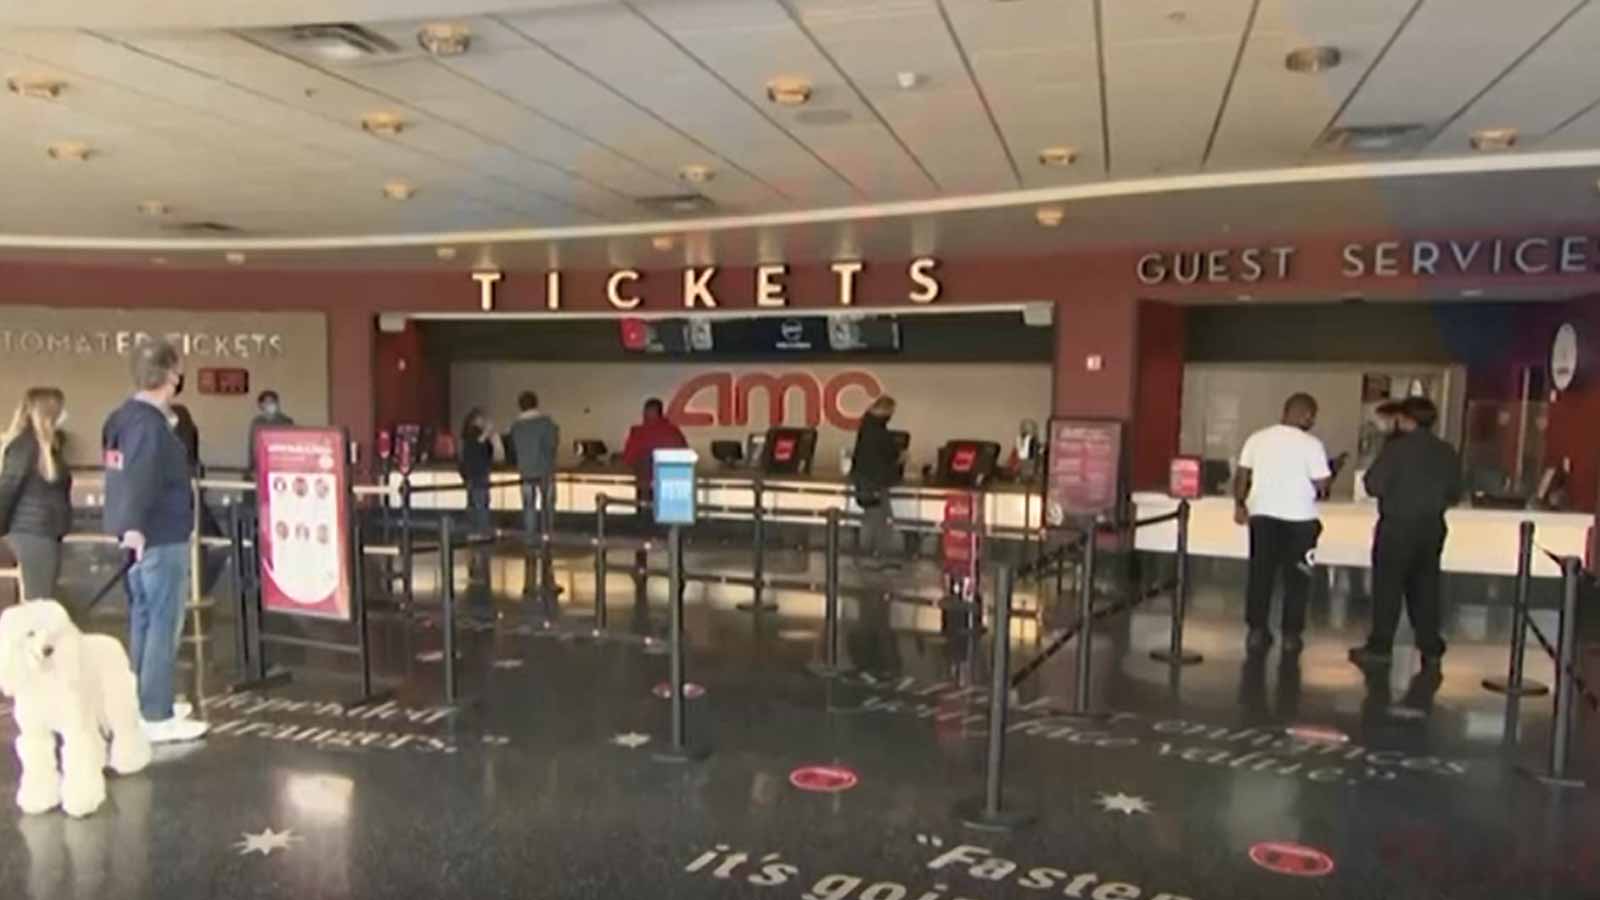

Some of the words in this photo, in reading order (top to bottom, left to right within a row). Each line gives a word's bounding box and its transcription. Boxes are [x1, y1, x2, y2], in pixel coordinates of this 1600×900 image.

[471, 257, 939, 311] TICKETS
[1136, 247, 1296, 284] GUEST
[686, 844, 799, 886] it's
[801, 872, 982, 900] goi
[914, 833, 1196, 900] “Faste
